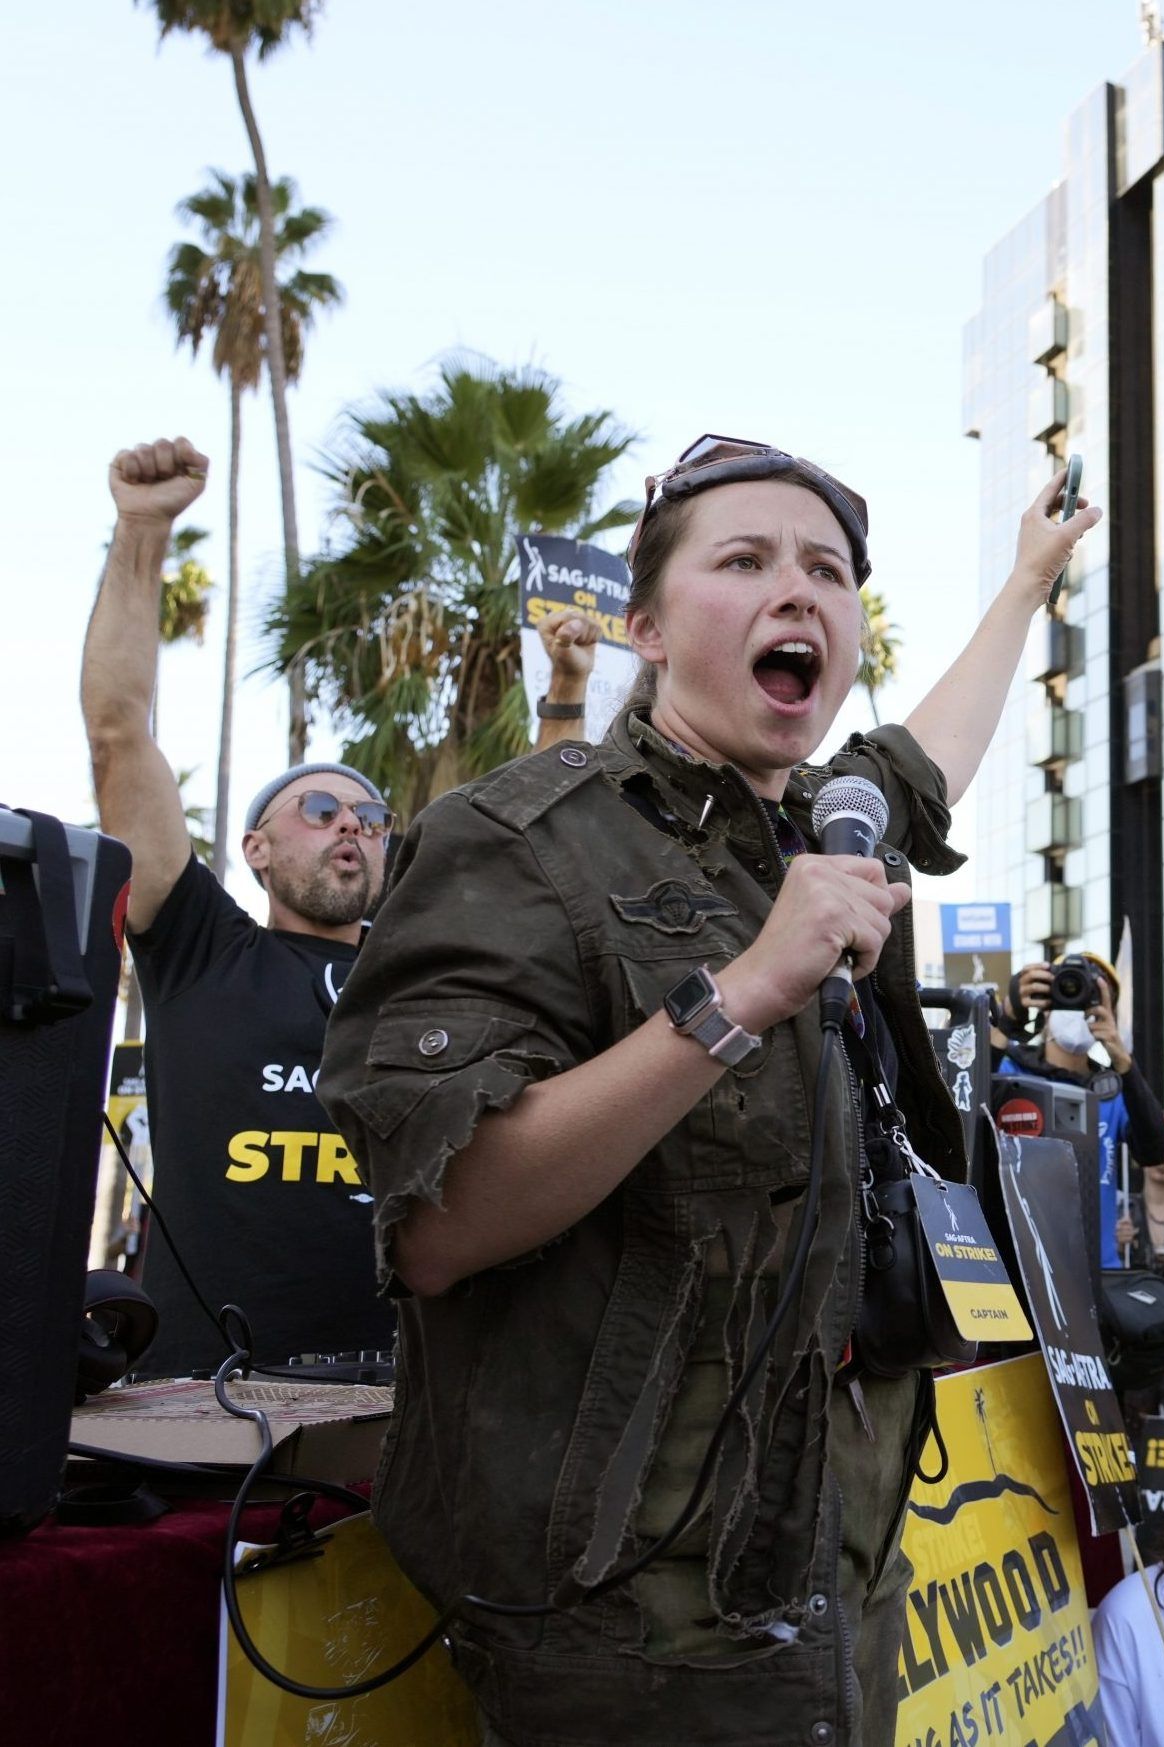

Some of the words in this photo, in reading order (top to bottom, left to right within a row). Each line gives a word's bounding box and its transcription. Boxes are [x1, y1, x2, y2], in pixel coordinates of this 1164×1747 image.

[573, 590, 597, 607] ON
[935, 1242, 953, 1258] ON
[953, 1245, 997, 1262] STRIKE!
[970, 1309, 1008, 1319] CAPTAIN
[1075, 1431, 1137, 1486] STRIKE!
[980, 1681, 1004, 1736] IT
[1006, 1624, 1087, 1719] TAKES!!
